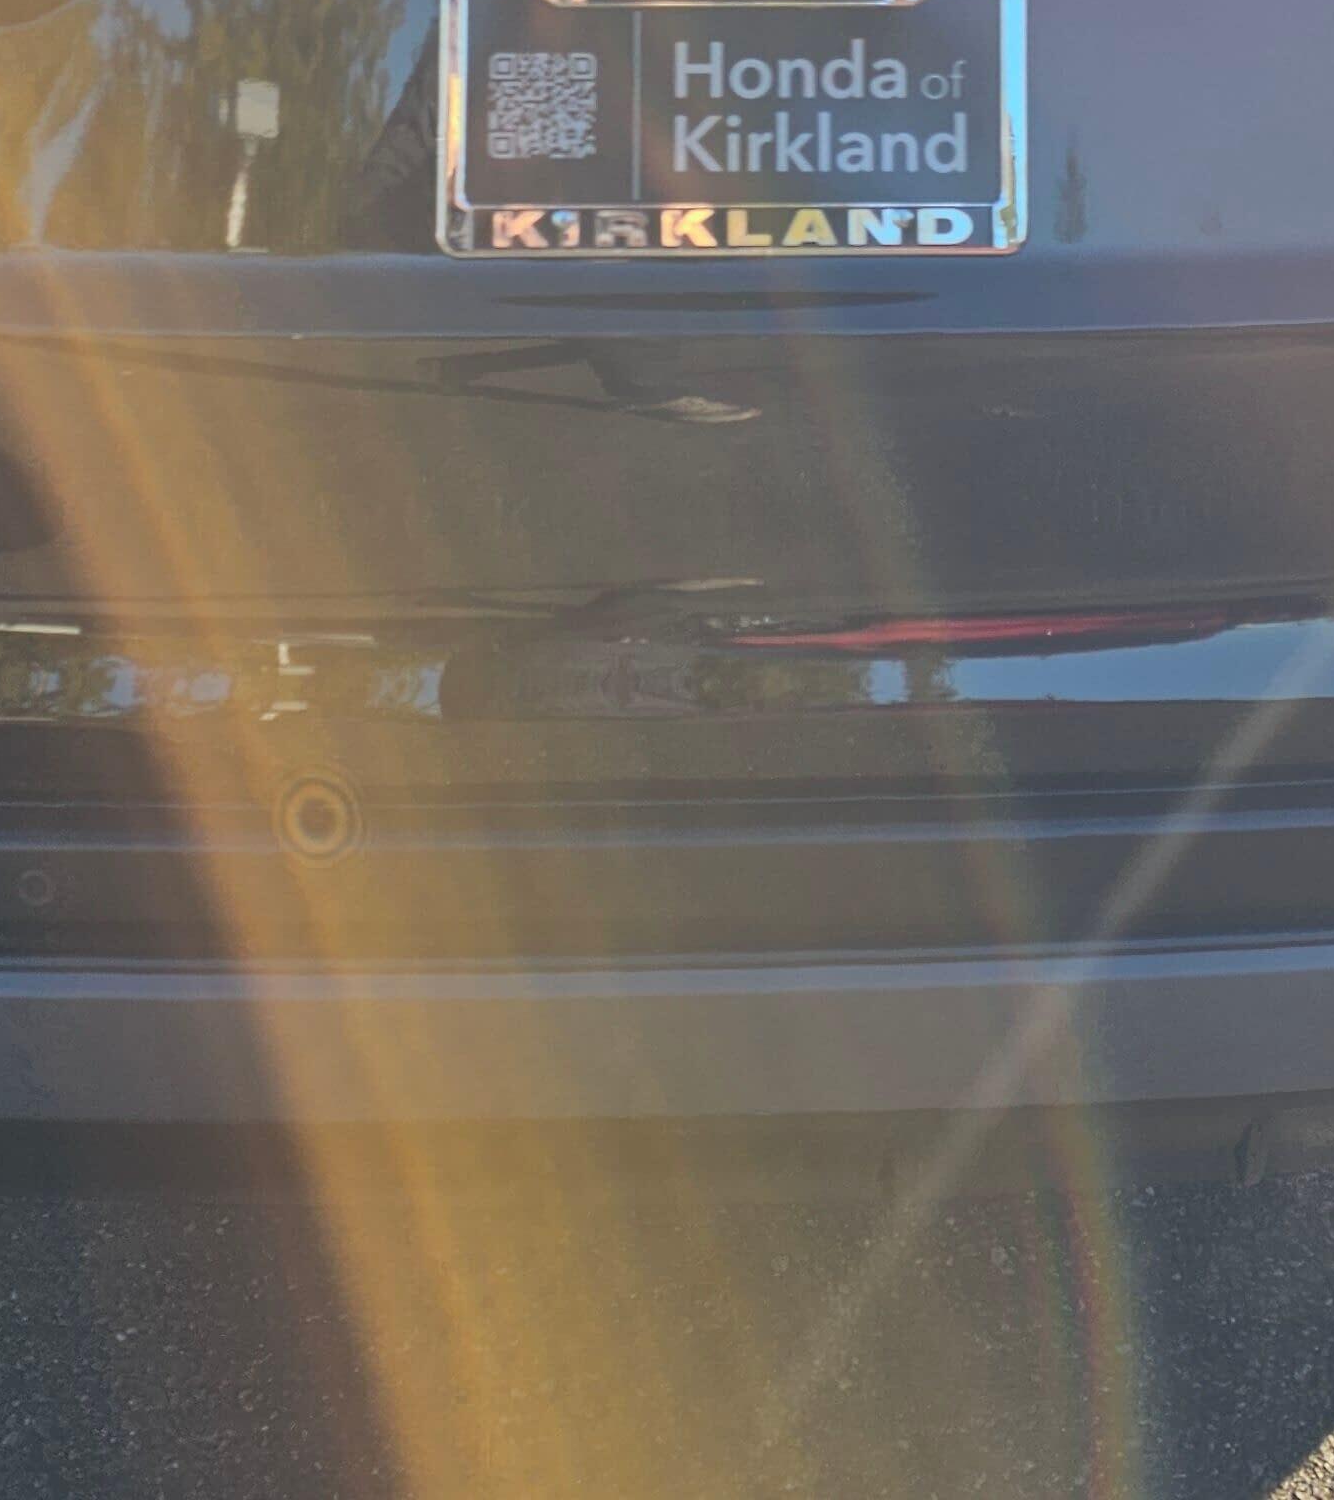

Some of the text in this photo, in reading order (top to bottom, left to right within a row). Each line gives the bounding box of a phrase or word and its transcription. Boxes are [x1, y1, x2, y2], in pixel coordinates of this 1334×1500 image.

[673, 38, 966, 100] Honda of
[673, 111, 967, 174] Kirkland
[490, 208, 974, 249] KIRKLAND
